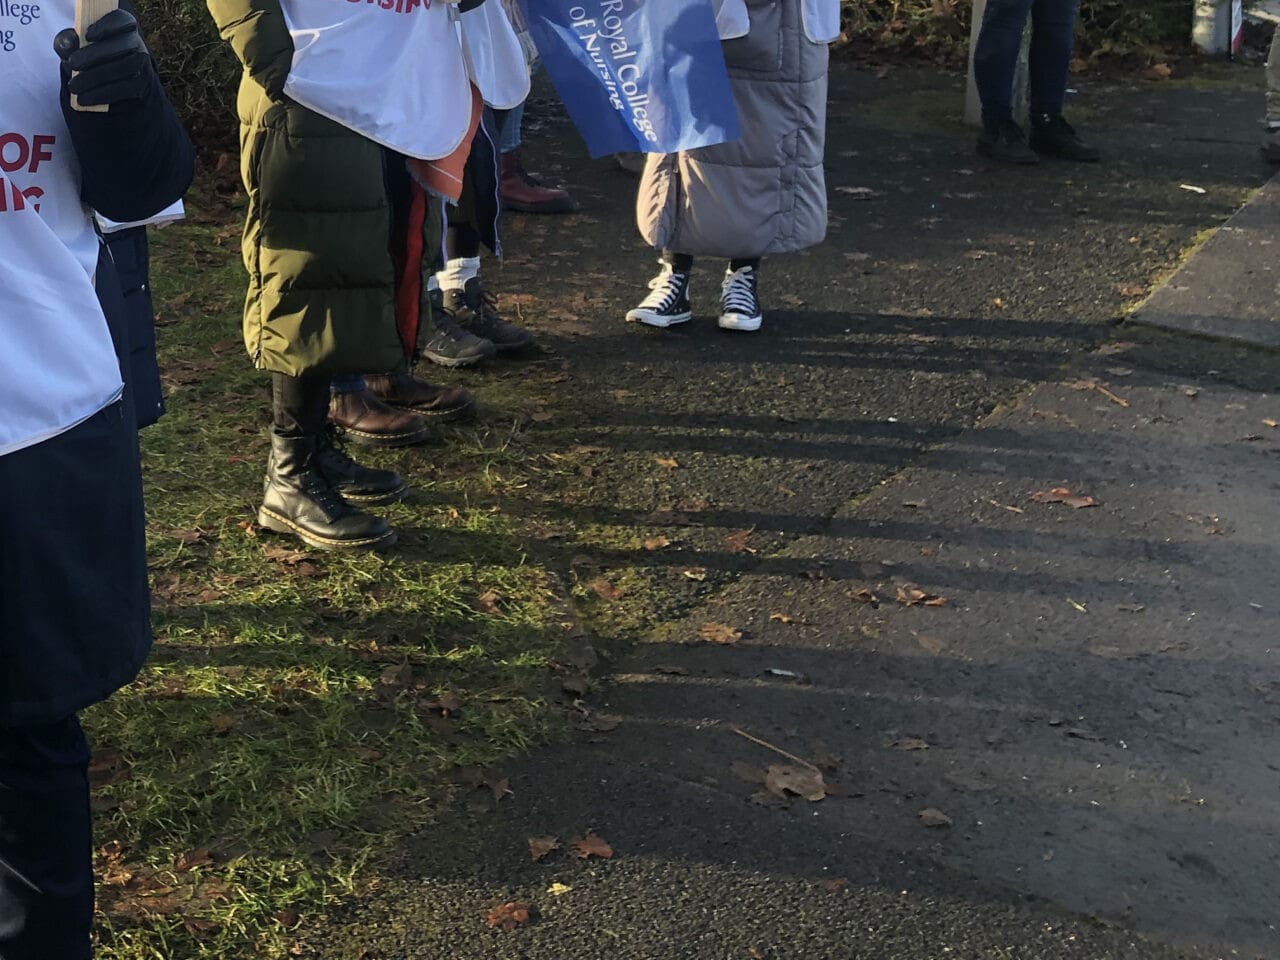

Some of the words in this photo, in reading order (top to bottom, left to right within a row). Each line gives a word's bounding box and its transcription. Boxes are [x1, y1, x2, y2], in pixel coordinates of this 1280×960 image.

[569, 6, 596, 29] of
[580, 32, 625, 111] Nursing
[617, 63, 658, 143] College
